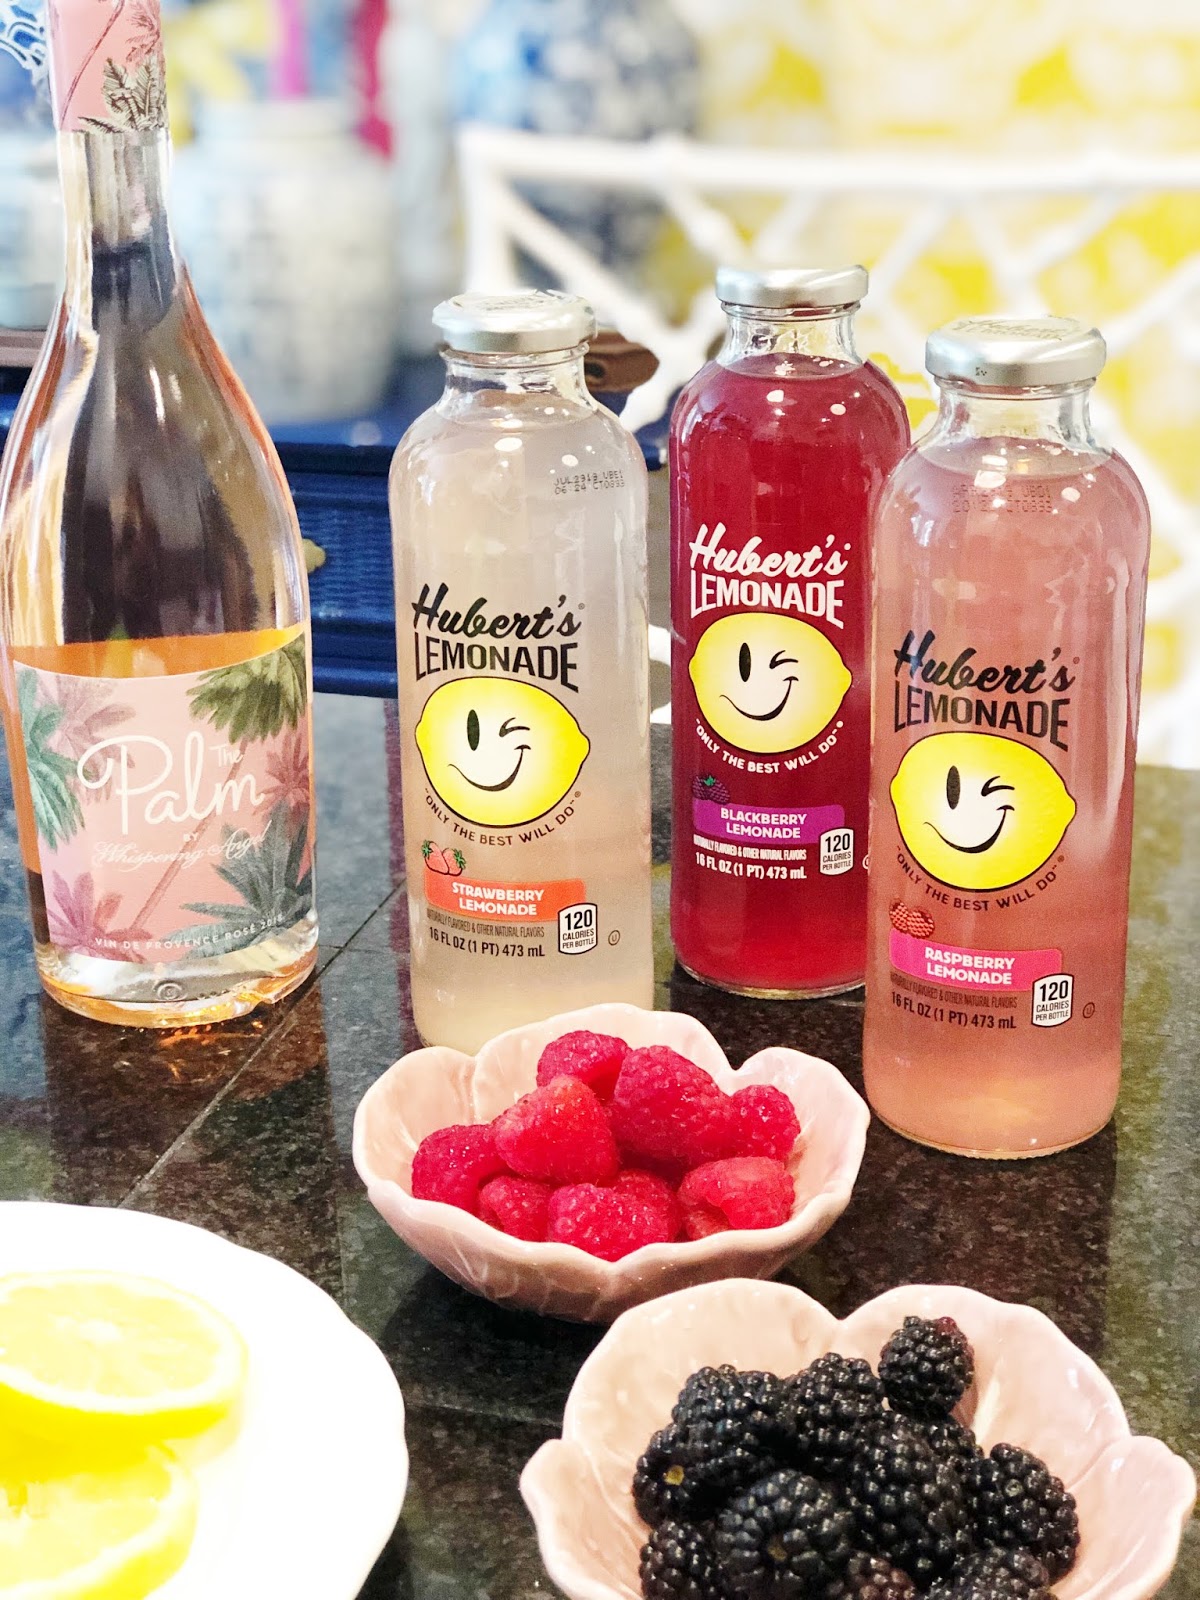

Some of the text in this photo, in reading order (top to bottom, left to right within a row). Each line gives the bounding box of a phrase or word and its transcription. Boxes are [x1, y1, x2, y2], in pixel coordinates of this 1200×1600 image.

[688, 521, 849, 579] Hubert's
[411, 581, 582, 640] Hubert's
[690, 569, 845, 630] LEMONADE
[414, 631, 579, 694] LEMONADE
[893, 629, 1076, 695] Hubert's
[894, 679, 1071, 752] LEMONADE
[209, 743, 244, 768] The
[722, 750, 745, 770] THE
[747, 761, 780, 774] BEST
[785, 752, 819, 772] WILL
[77, 731, 266, 835] Palm
[720, 807, 807, 826] BLACKBERRY
[453, 822, 476, 843] THE
[479, 834, 514, 847] BEST
[518, 822, 555, 844] WILL
[726, 821, 801, 839] LEMONADE
[825, 833, 850, 853] 120
[695, 851, 807, 880] 16 FL OZ (1 PT) 473 mL
[822, 851, 852, 864] CALORIES
[822, 859, 852, 871] PER BOTTLE
[452, 881, 545, 902] STRAWBERRY
[925, 883, 950, 906] THE
[953, 897, 990, 912] BEST
[996, 887, 1036, 909] WILL
[459, 896, 538, 916] LEMONADE
[494, 924, 520, 938] NATURAL
[520, 926, 545, 938] FLAVORS
[564, 909, 593, 931] 120
[94, 937, 117, 949] VIN
[123, 940, 140, 951] DE
[145, 934, 219, 950] PROVENCE
[429, 926, 546, 957] 16 FL OZ (1 PT) 473 mL
[562, 927, 595, 941] CALORIES
[562, 937, 595, 949] PER BOTTLE
[924, 946, 1016, 970] RASPBERRY
[926, 962, 1013, 985] LEMONADE
[1039, 980, 1069, 1002] 120
[891, 991, 1017, 1029] 16 FL OZ (1 PT) 473 mL
[1035, 1010, 1069, 1021] PER BOTTLE
[1036, 1000, 1070, 1013] CALORIES
